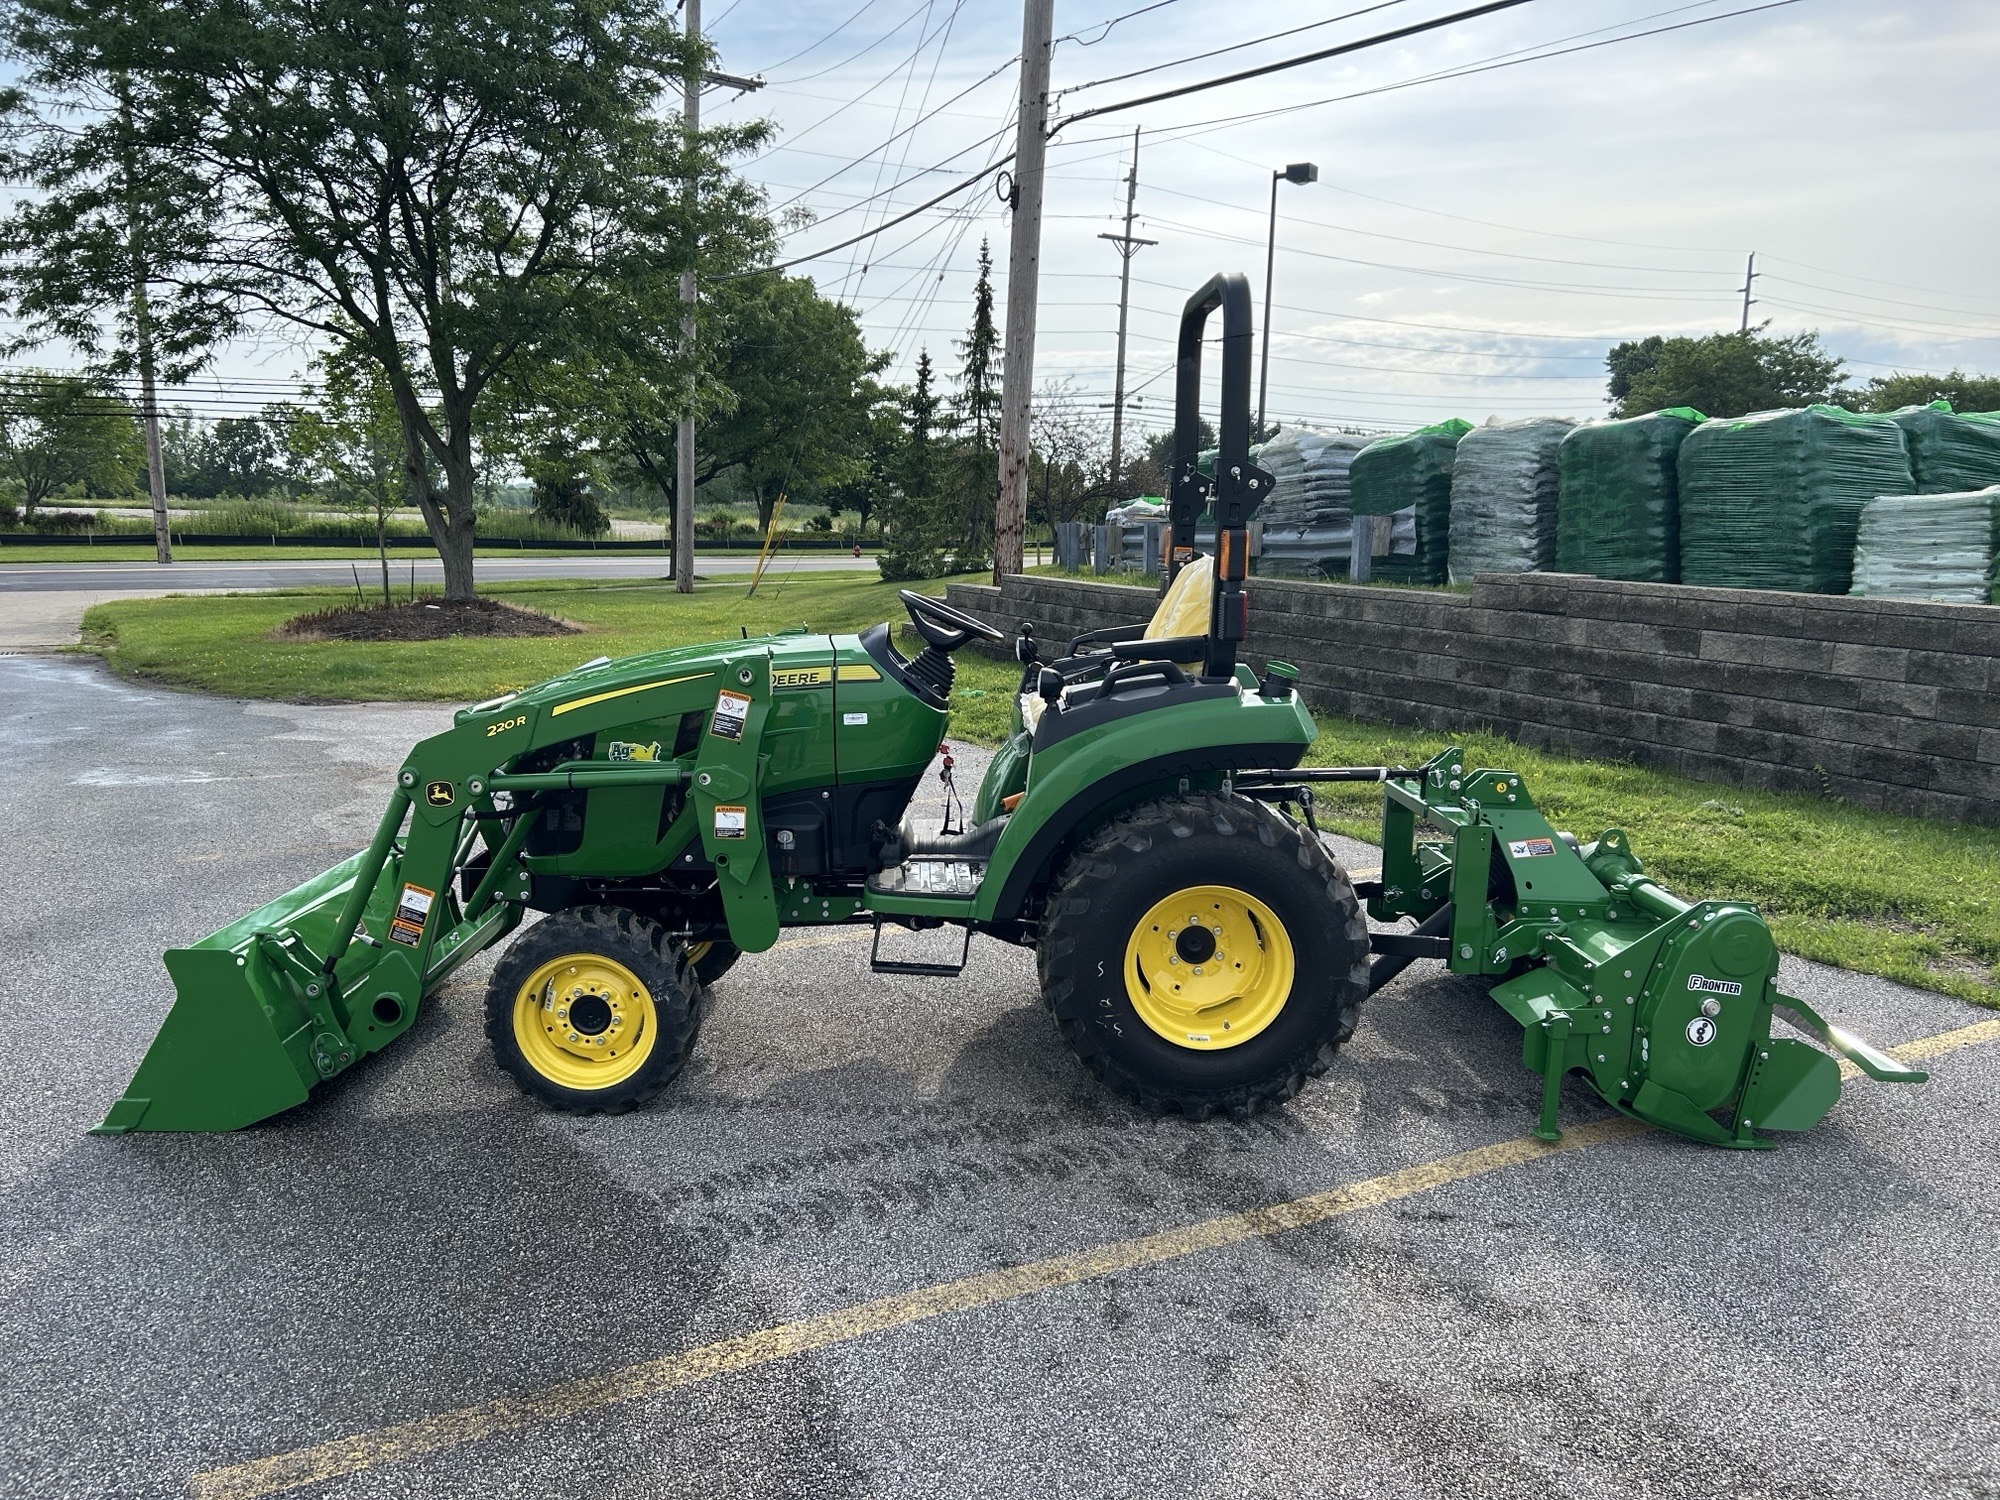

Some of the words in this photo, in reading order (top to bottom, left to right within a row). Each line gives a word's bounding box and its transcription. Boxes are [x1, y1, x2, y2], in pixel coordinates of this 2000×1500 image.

[486, 719, 515, 738] 220
[516, 715, 527, 727] R
[1689, 975, 1741, 994] FRONTIER
